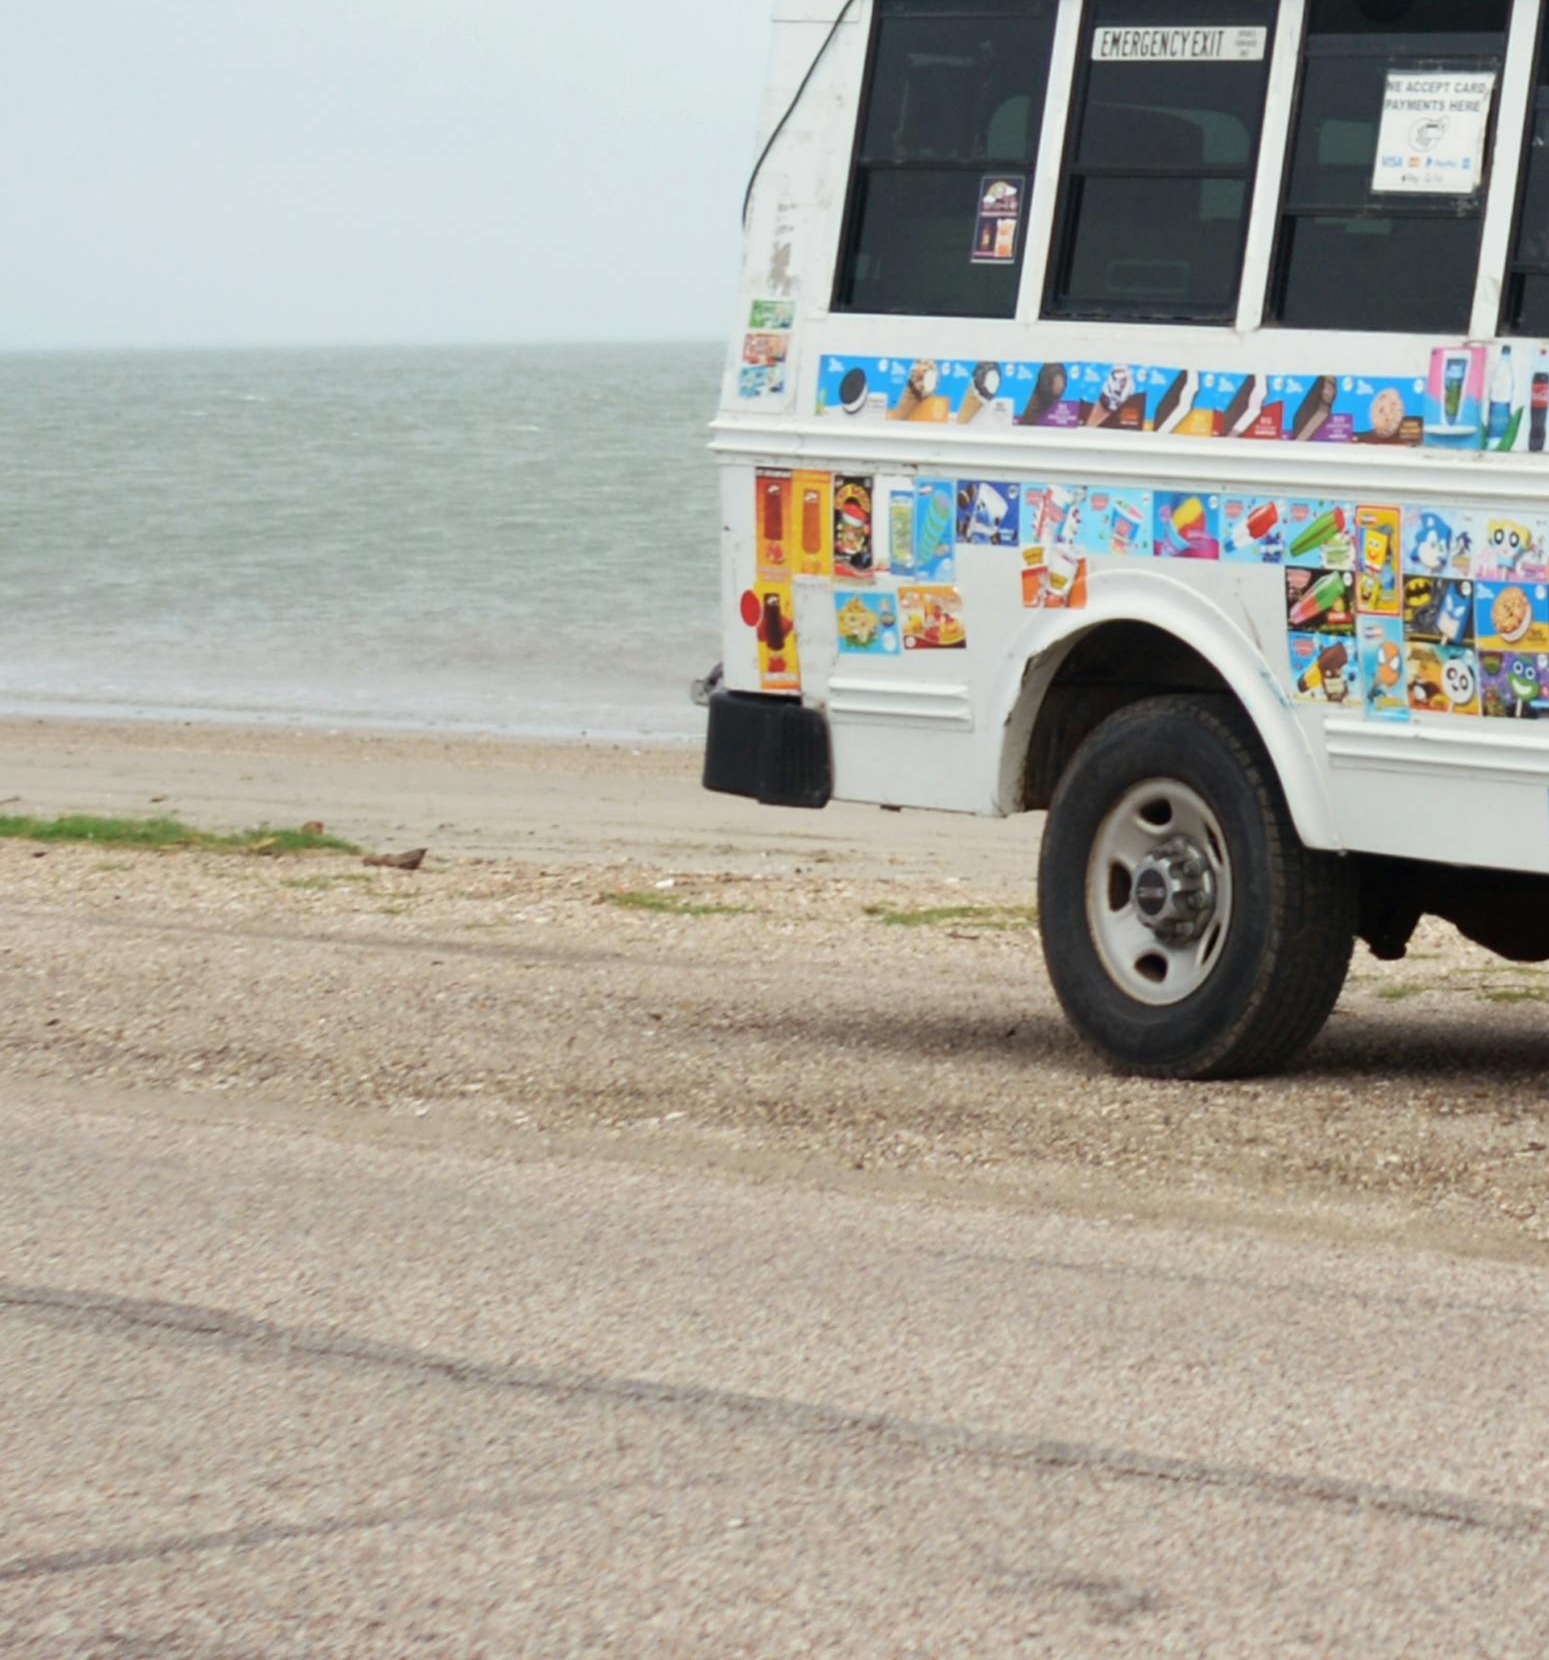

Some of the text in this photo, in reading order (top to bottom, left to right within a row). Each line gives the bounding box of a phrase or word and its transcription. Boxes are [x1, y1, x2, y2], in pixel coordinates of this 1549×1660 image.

[1101, 30, 1191, 57] EMERGENCY
[1191, 30, 1225, 57] EXIT
[1406, 81, 1451, 93] ACCEPT
[1385, 99, 1481, 112] PAYMENTS HERE
